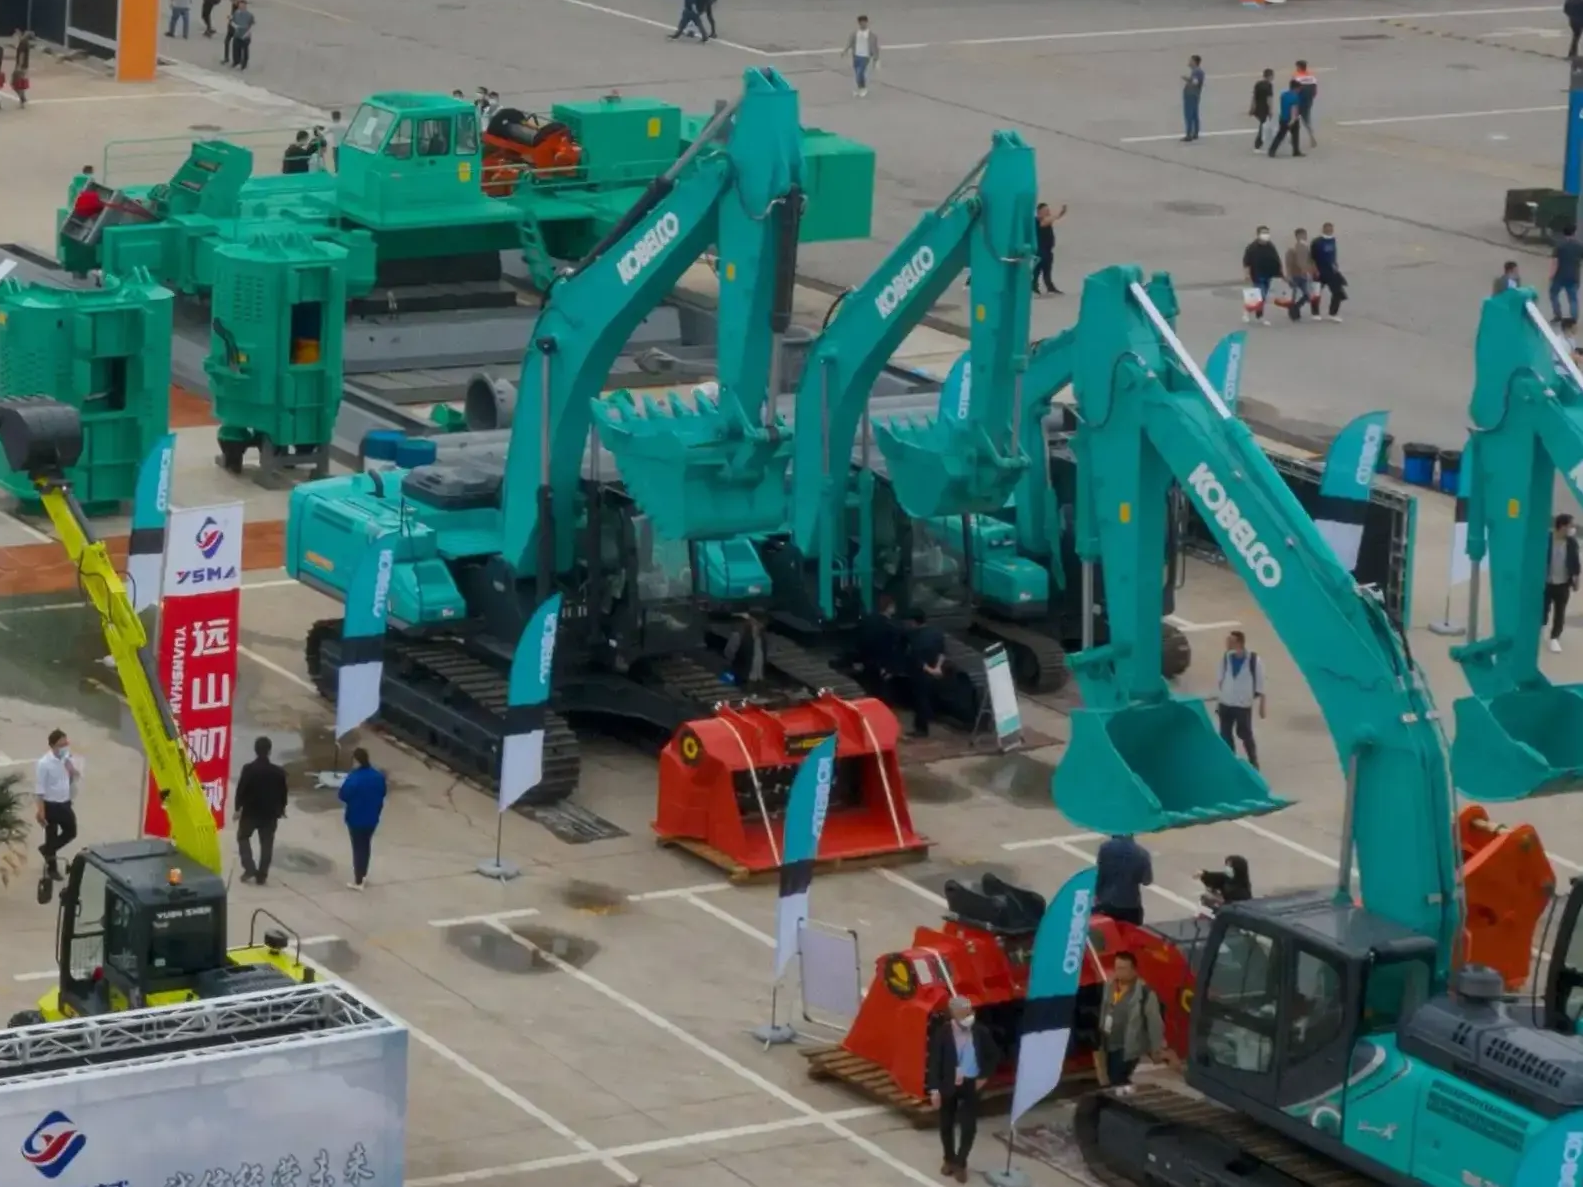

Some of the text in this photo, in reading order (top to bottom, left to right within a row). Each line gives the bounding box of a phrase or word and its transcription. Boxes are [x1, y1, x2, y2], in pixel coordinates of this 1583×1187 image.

[616, 211, 679, 285] KOBELCO
[874, 245, 935, 320] KOBELCO
[1187, 462, 1282, 587] KOBELCO
[176, 566, 238, 586] YSMA
[1063, 889, 1090, 975] KOBELCO
